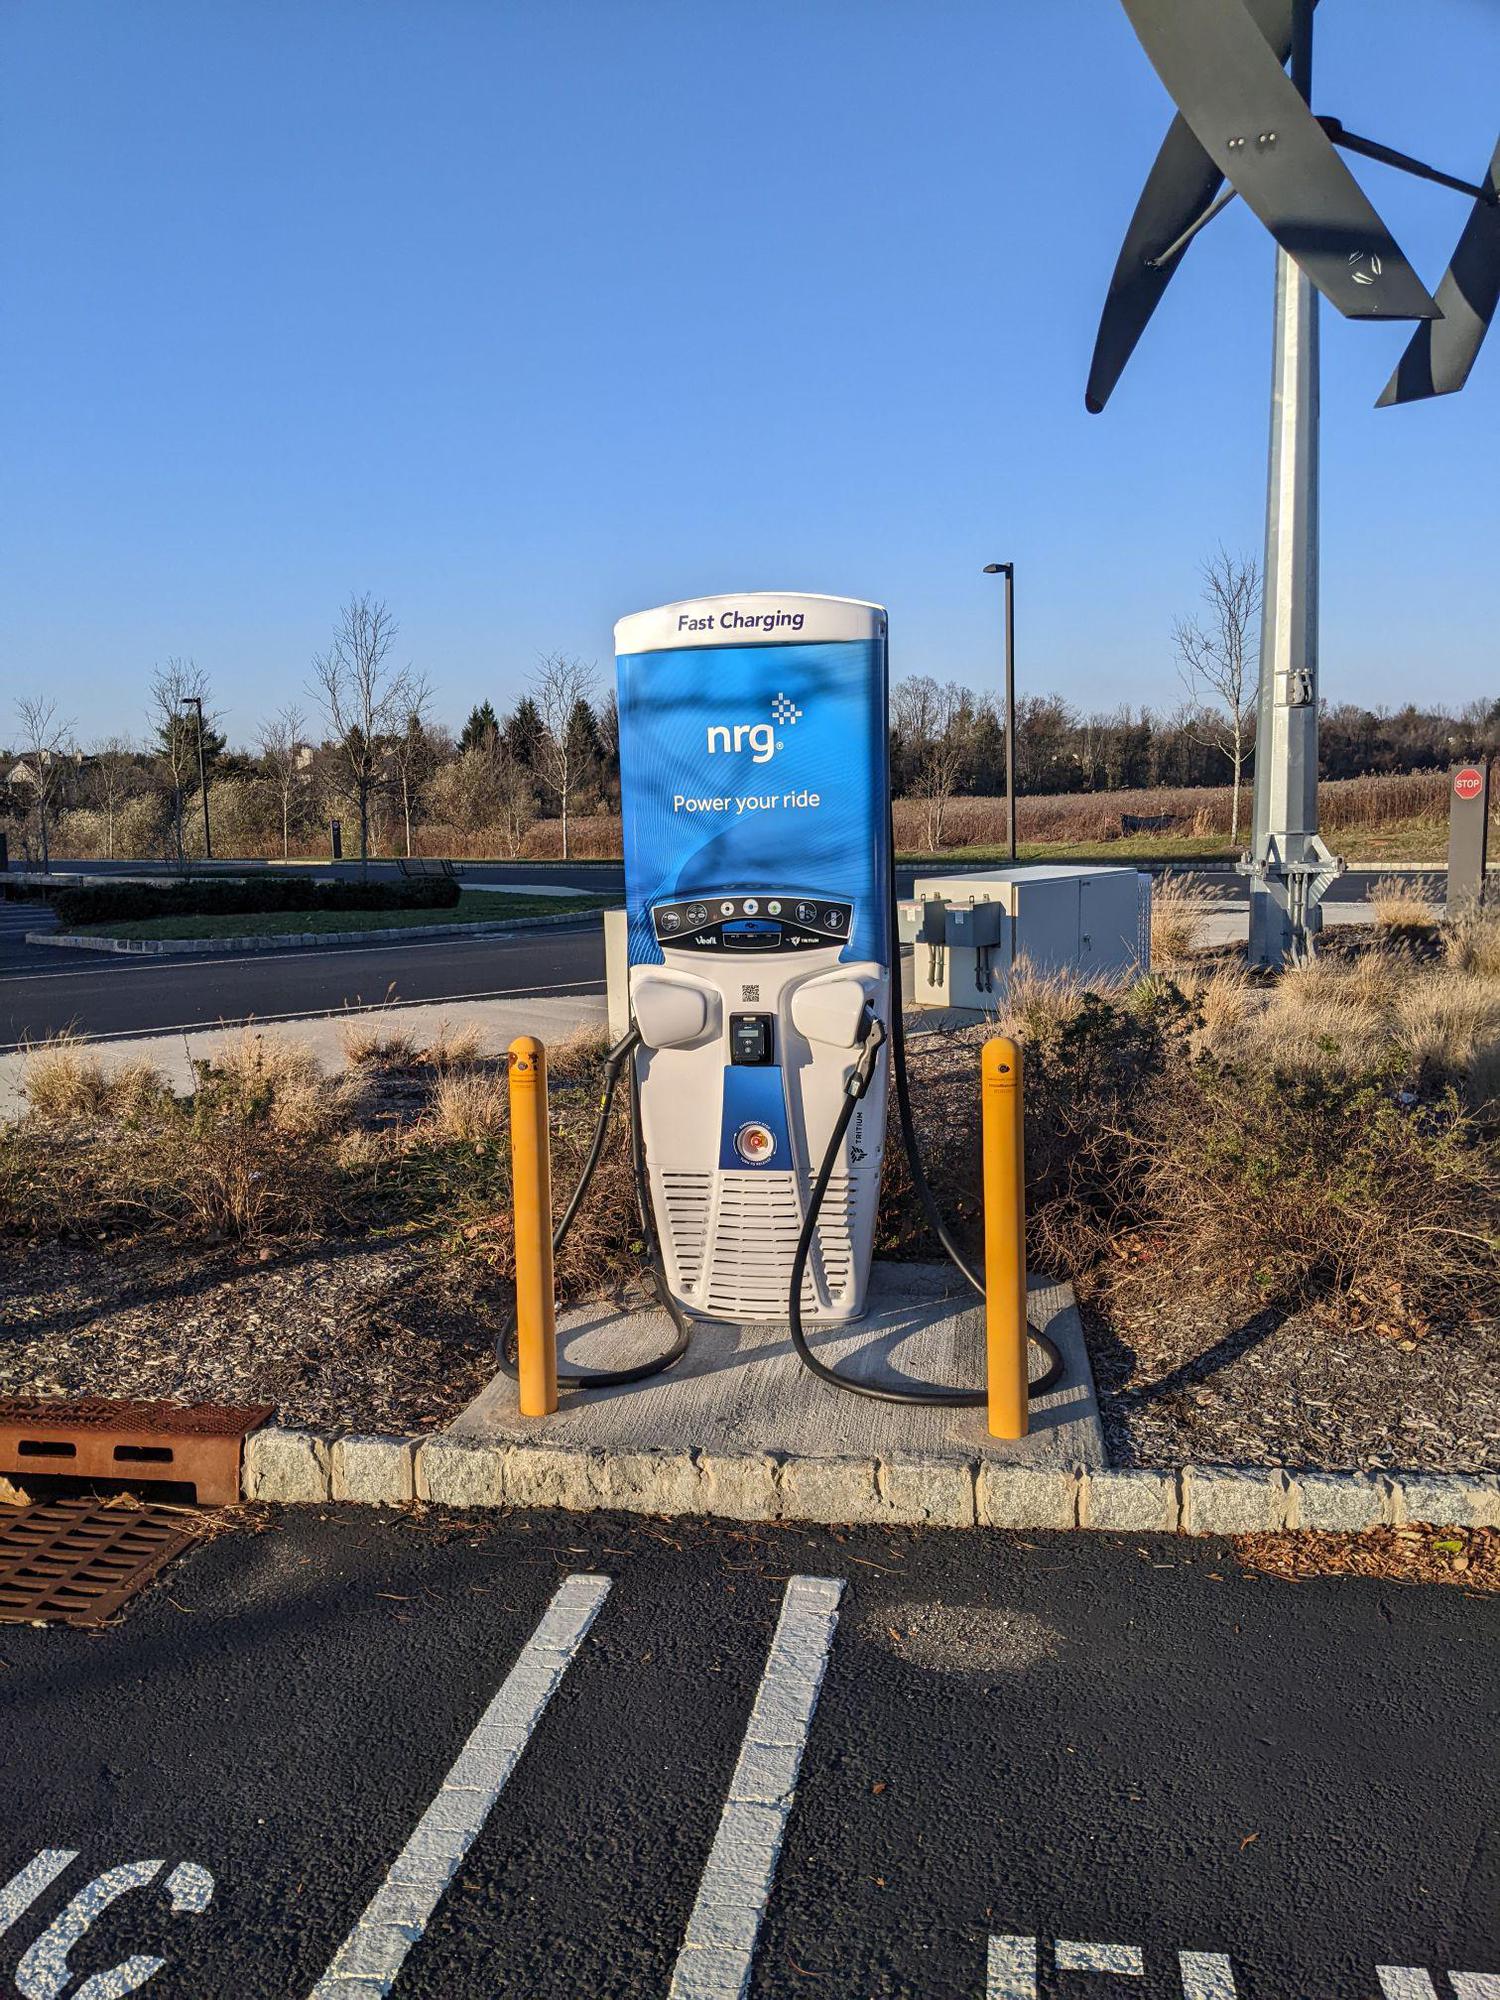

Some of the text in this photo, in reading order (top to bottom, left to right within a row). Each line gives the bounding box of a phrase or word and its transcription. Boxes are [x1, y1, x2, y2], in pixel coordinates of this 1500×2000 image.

[678, 610, 805, 632] Fast Charging
[707, 724, 775, 763] nrg
[1456, 779, 1480, 789] STOP
[673, 790, 820, 815] Power your ride
[855, 1111, 863, 1144] TRITIUM
